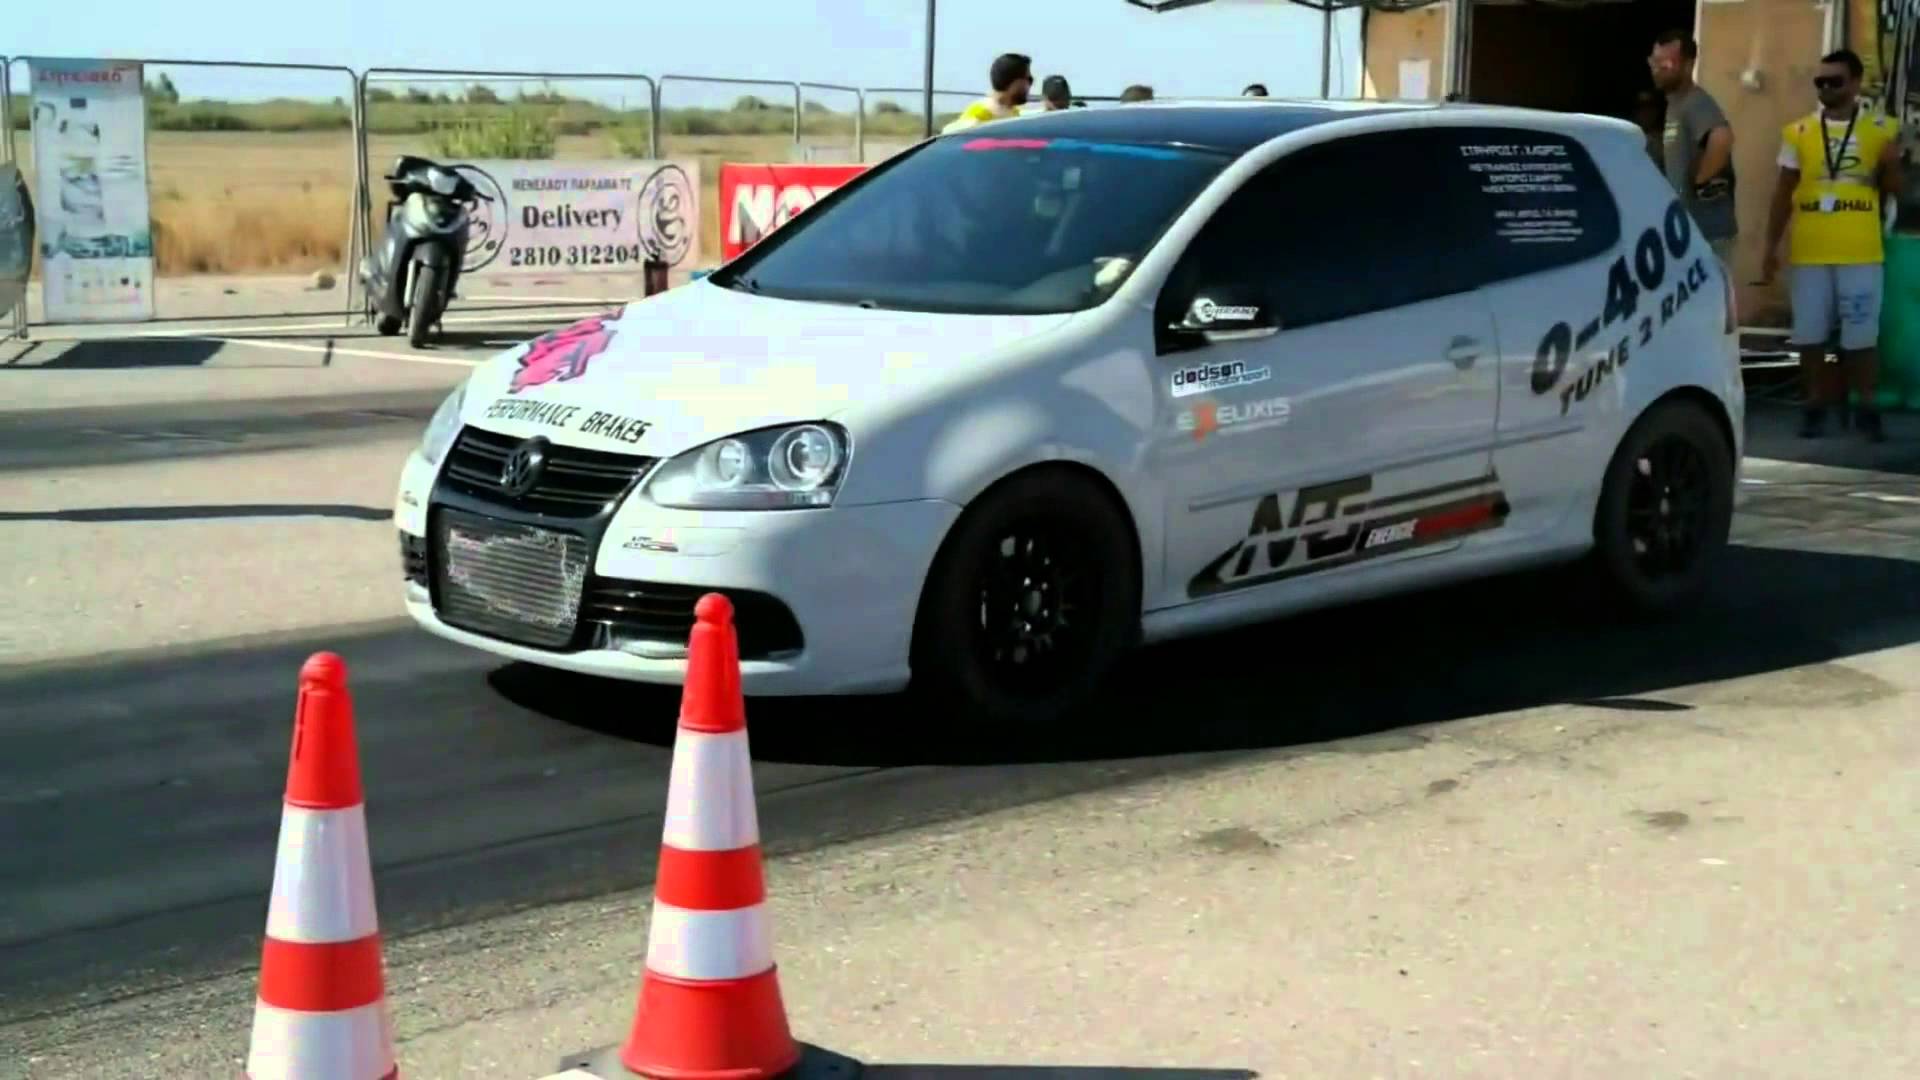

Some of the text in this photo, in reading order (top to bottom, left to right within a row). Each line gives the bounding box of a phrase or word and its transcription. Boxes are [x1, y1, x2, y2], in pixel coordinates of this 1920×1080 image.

[522, 204, 623, 232] Delivery
[510, 245, 640, 266] 2810 312204
[1660, 258, 1709, 327] RACE
[579, 411, 653, 444] BRAKES
